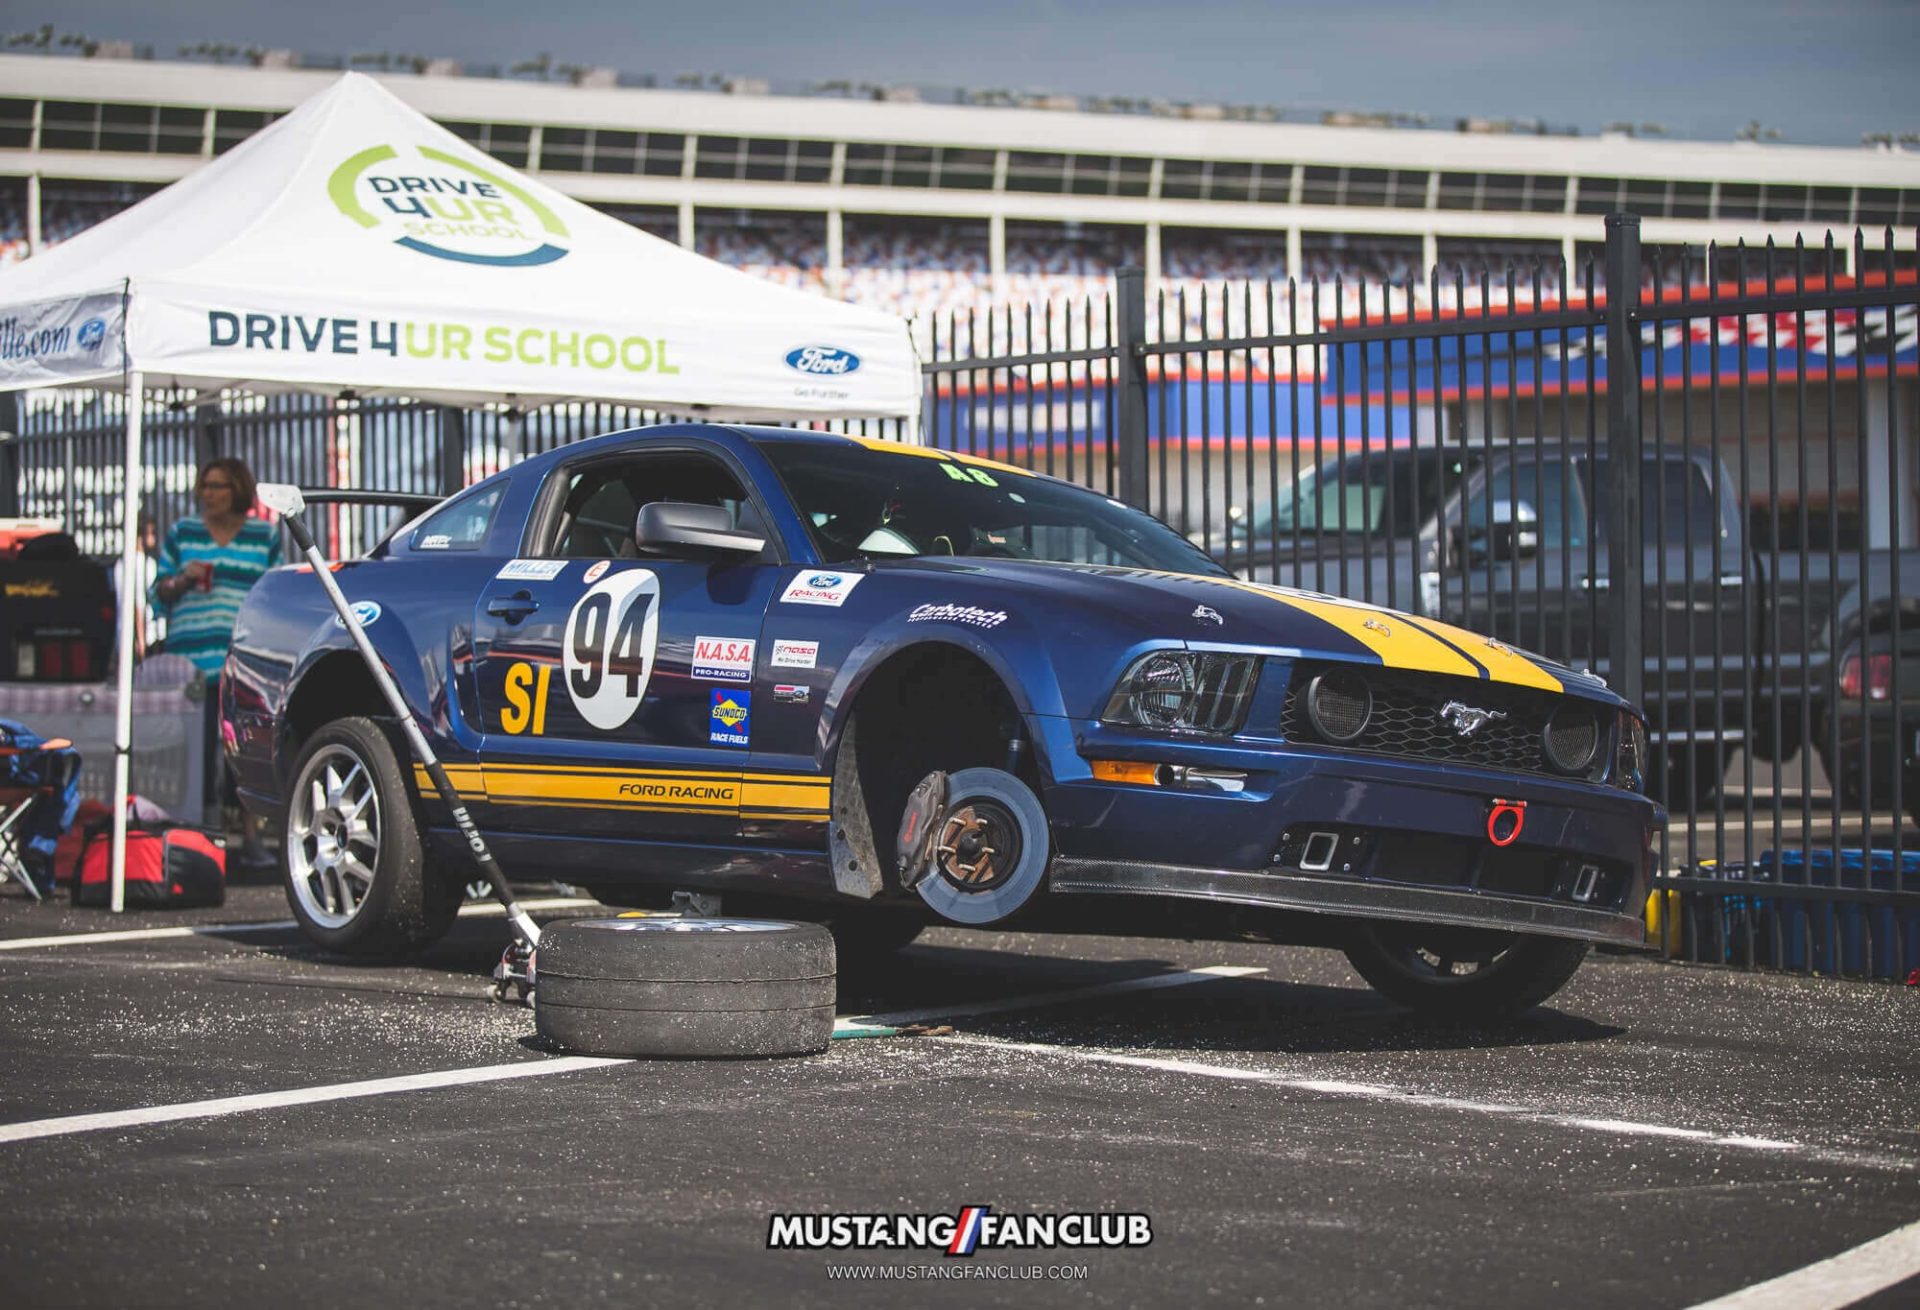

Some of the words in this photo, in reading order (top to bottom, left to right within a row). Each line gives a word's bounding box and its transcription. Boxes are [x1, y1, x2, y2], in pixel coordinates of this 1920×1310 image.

[368, 176, 501, 198] DRIVE
[382, 197, 518, 225] 4UR
[403, 222, 537, 240] SCHOOL
[208, 311, 358, 354] DRIVE
[484, 326, 680, 375] SCHOOL
[797, 346, 849, 374] Ford
[789, 589, 841, 601] RACING
[571, 592, 655, 699] 94
[695, 641, 752, 663] N.A.S.A.
[695, 668, 747, 679] PRO-RACING
[501, 662, 552, 735] SI
[714, 706, 746, 720] SUNOCO
[710, 732, 728, 743] RACE
[728, 734, 749, 744] FUELS
[619, 783, 666, 797] FORD
[668, 786, 735, 800] RACING
